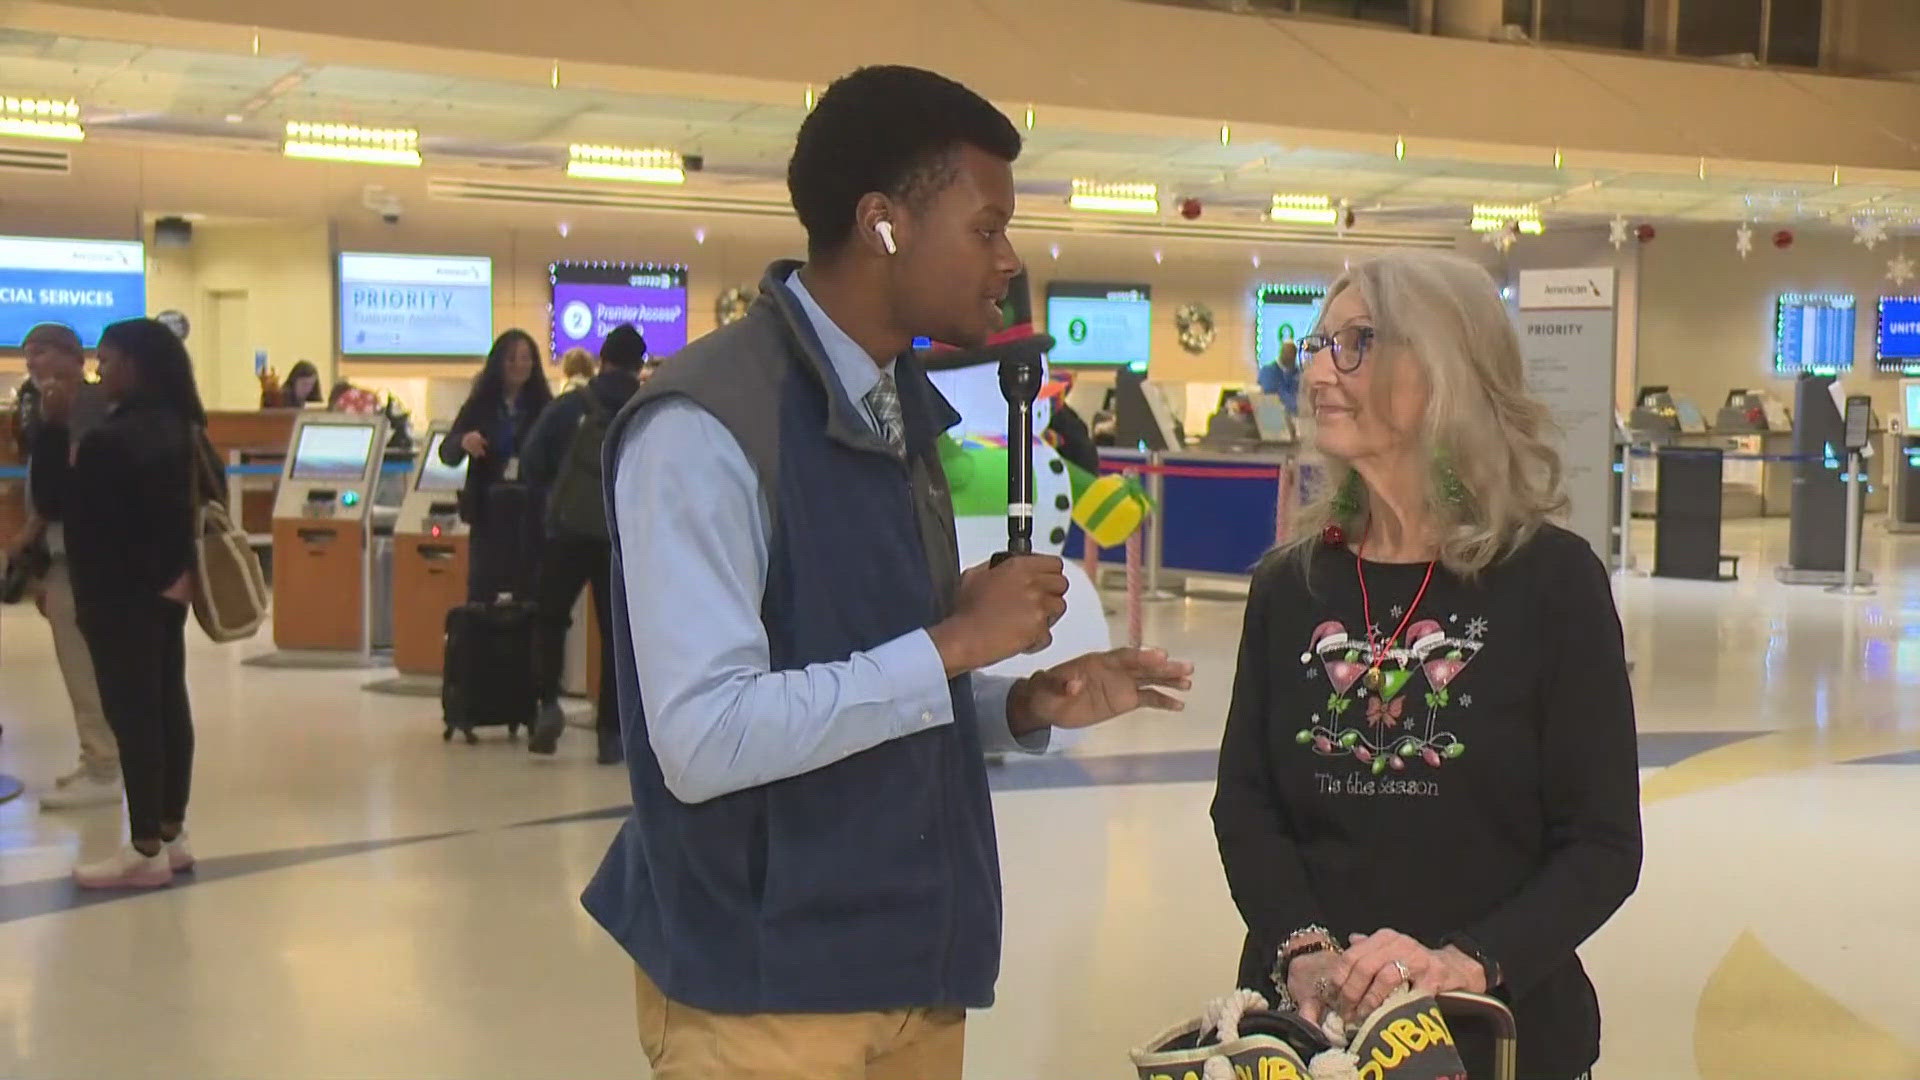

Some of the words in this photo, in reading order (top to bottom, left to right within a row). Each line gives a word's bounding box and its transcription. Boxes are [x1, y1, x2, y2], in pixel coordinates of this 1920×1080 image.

[39, 288, 115, 307] SERVICES
[1544, 283, 1588, 295] American
[353, 289, 453, 310] PRIORITY
[1527, 323, 1583, 336] PRIORITY
[1346, 771, 1376, 796] the
